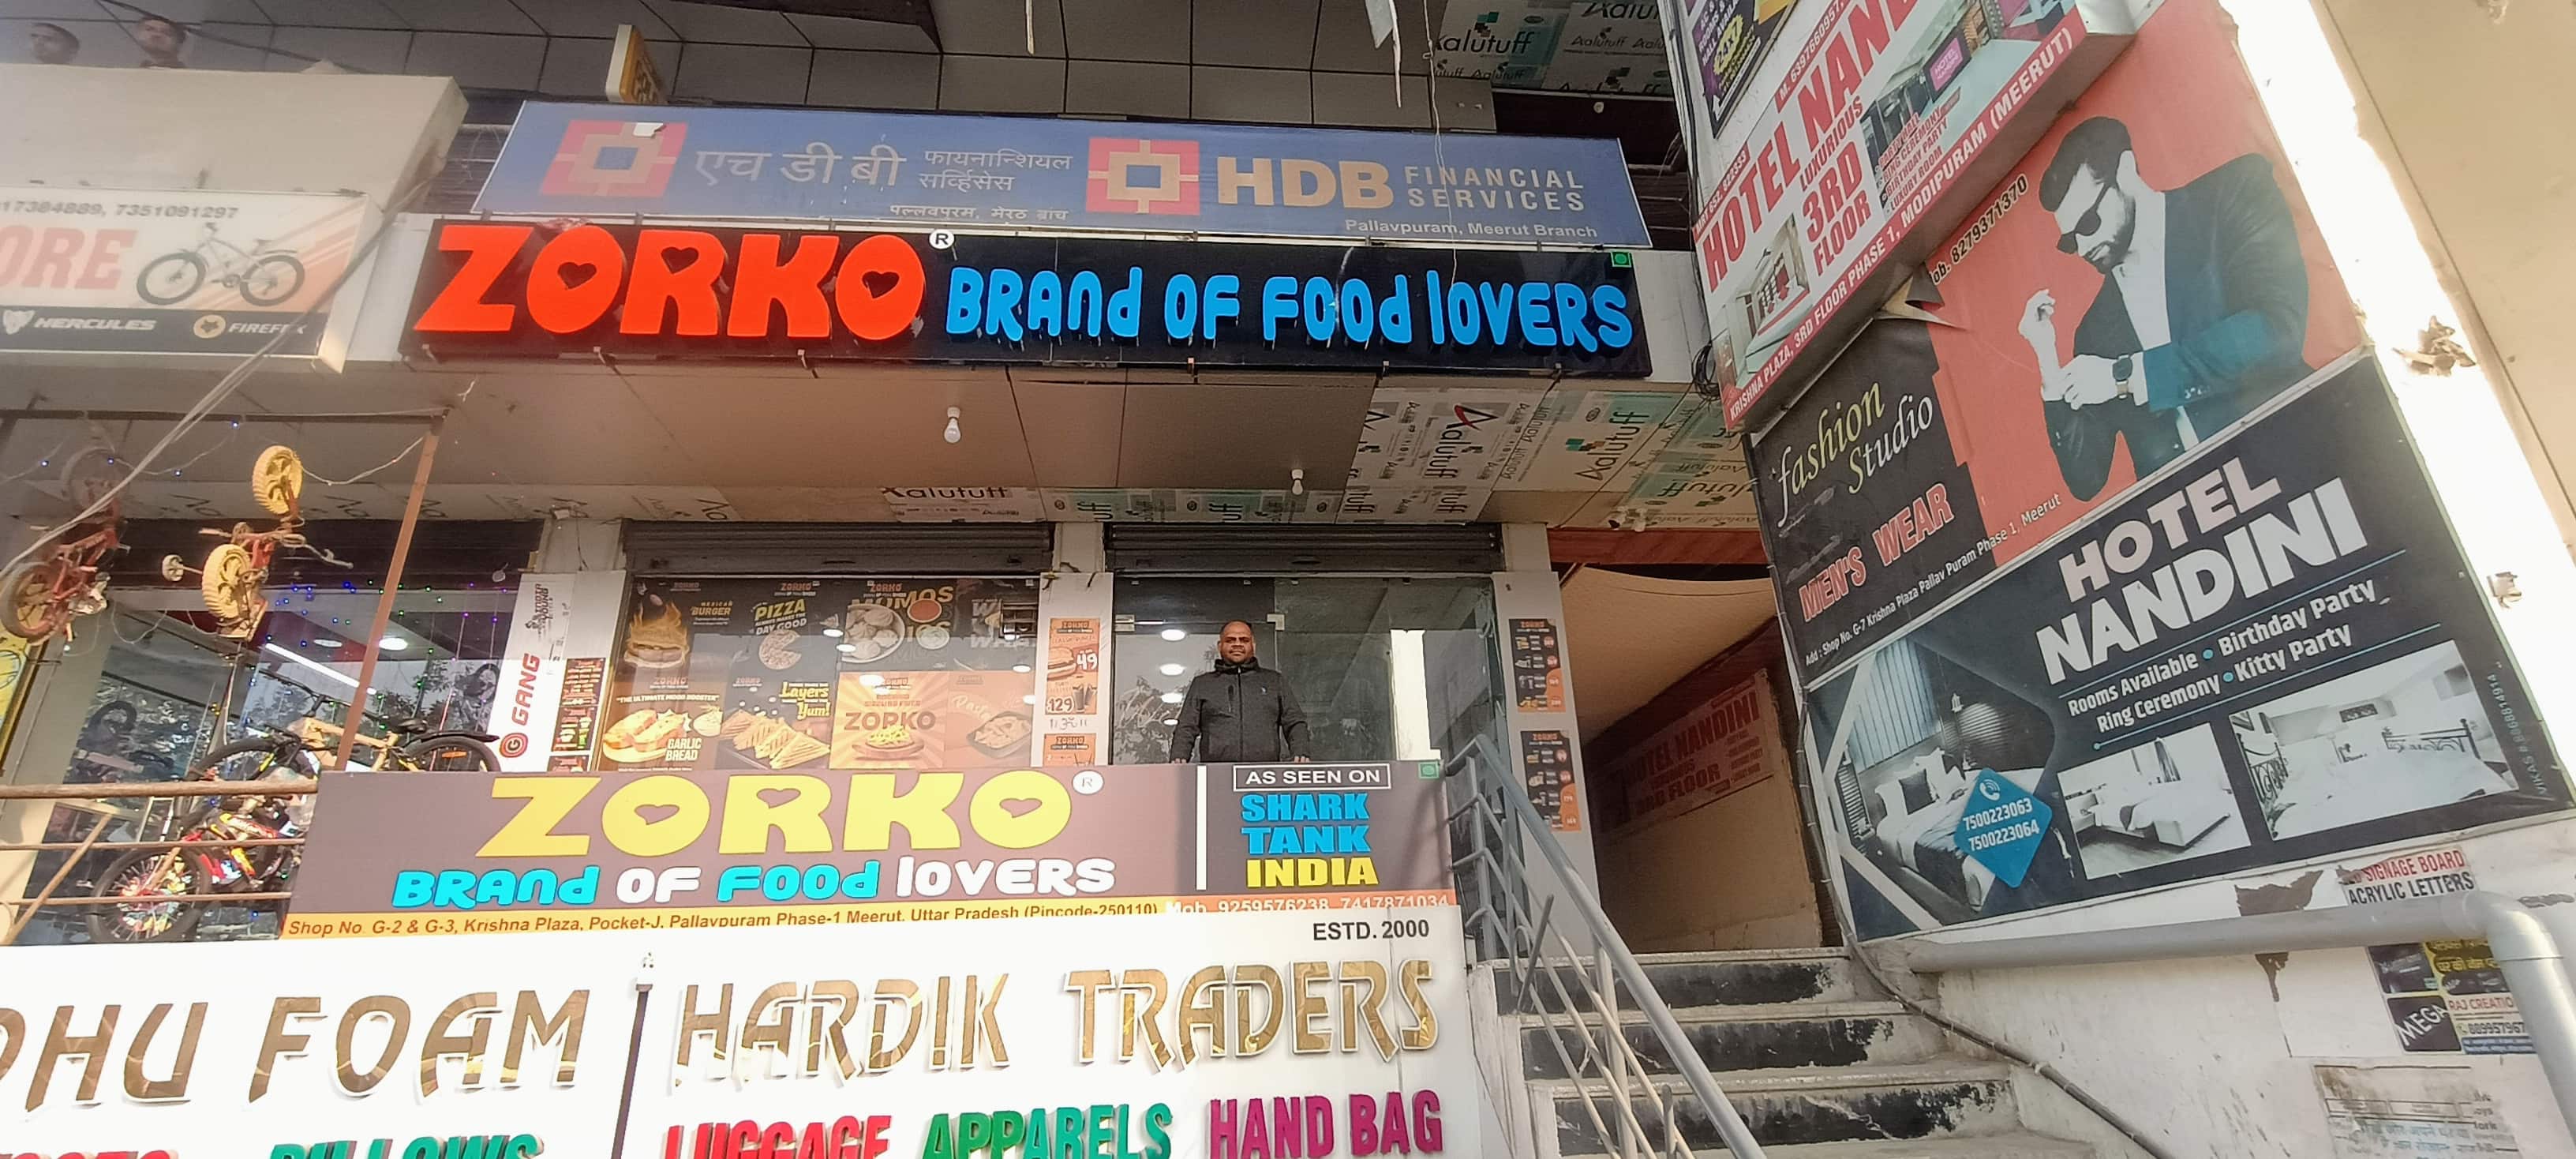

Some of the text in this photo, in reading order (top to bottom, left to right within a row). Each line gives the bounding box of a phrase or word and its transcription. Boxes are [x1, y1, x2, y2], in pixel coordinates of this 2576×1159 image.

[695, 141, 907, 186] एच डी बी
[1799, 96, 1866, 193] LUXURIOUS
[1885, 150, 1923, 199] BIRTHDAY
[1923, 116, 1949, 153] PARTY
[1918, 145, 1944, 179] ROOM
[1215, 156, 1395, 210] HDB
[1403, 165, 1585, 189] FINANCIAL
[1801, 141, 1863, 242] 3RD
[1407, 188, 1586, 211] SERVICES
[1700, 118, 1801, 294] HOTEL
[1951, 174, 2028, 264] 8279371370
[1345, 219, 1599, 238] Pallavpuram, Meerut Branch
[1729, 373, 1765, 421] KRISHNA
[1764, 343, 1794, 385] PLAZA,
[1793, 321, 1814, 350] 3RD
[1814, 283, 1848, 328] FLOOR
[1848, 242, 1887, 290] PHASE
[1900, 122, 1989, 230] MODIPURAM
[1990, 27, 2074, 131] (MEERUT)
[1814, 189, 1871, 276] FLOOR
[414, 224, 927, 340] ZORKO
[34, 317, 156, 331] HERCULES
[1163, 272, 1241, 342] OF
[1777, 382, 1886, 527] fashion
[1848, 394, 1934, 494] Studio
[2057, 456, 2282, 603] HOTEL
[1799, 482, 1956, 623] MEN'S WEAR
[1852, 618, 1866, 636] G-7
[1866, 601, 1896, 628] Krishna
[1896, 587, 1919, 607] Plaza
[1918, 570, 1946, 595] Pallav
[1945, 550, 1976, 577] Puram
[1976, 531, 2009, 557] Phase
[2020, 493, 2063, 527] Meerut
[2035, 476, 2368, 685] NANDINI
[691, 606, 732, 616] BURGER
[754, 598, 807, 621] PIZZA
[756, 617, 807, 636] DAY GOOD
[1076, 651, 1098, 671] 49
[2068, 580, 2376, 717] Rooms Available Birthday Party
[511, 653, 541, 726] GANG
[779, 681, 829, 701] Layers
[2096, 624, 2353, 734] Ring Ceremony Kitty Party
[796, 701, 831, 720] Yum!
[665, 749, 698, 762] BREAD
[668, 737, 702, 750] GARLIC
[1245, 767, 1381, 786] AS SEEN ON
[475, 770, 1073, 858] ZORKO
[1240, 792, 1370, 825] SHARK
[1963, 797, 2034, 831] 7500223063
[1240, 825, 1371, 855] TANK
[1968, 820, 2040, 852] 7500223064
[615, 866, 702, 905] OF
[1246, 857, 1379, 889] INDIA
[2361, 857, 2417, 882] SIGNAGE
[2417, 850, 2466, 873] BOARD
[2347, 871, 2475, 906] ACRYLIC LETTERS
[288, 921, 334, 938] Shop
[372, 920, 402, 934] G-2
[406, 919, 419, 933] &
[425, 918, 459, 936] G-3,
[463, 917, 530, 933] Krishna
[534, 916, 585, 932] Plaza,
[669, 913, 771, 929] Pallavpuram
[776, 910, 841, 926] Phase-1
[911, 907, 950, 922] Uttar
[953, 906, 1020, 921] Pradesh
[1312, 919, 1430, 942] ESTD. 2000
[675, 958, 1442, 1090] HARDIK TRADERS
[2398, 1003, 2450, 1046] MEGA
[2449, 999, 2468, 1011] RAJ
[248, 988, 591, 1105] FOAM
[925, 1102, 1174, 1159] APPARELS
[1208, 1094, 1337, 1159] HAND
[1348, 1089, 1445, 1157] BAG
